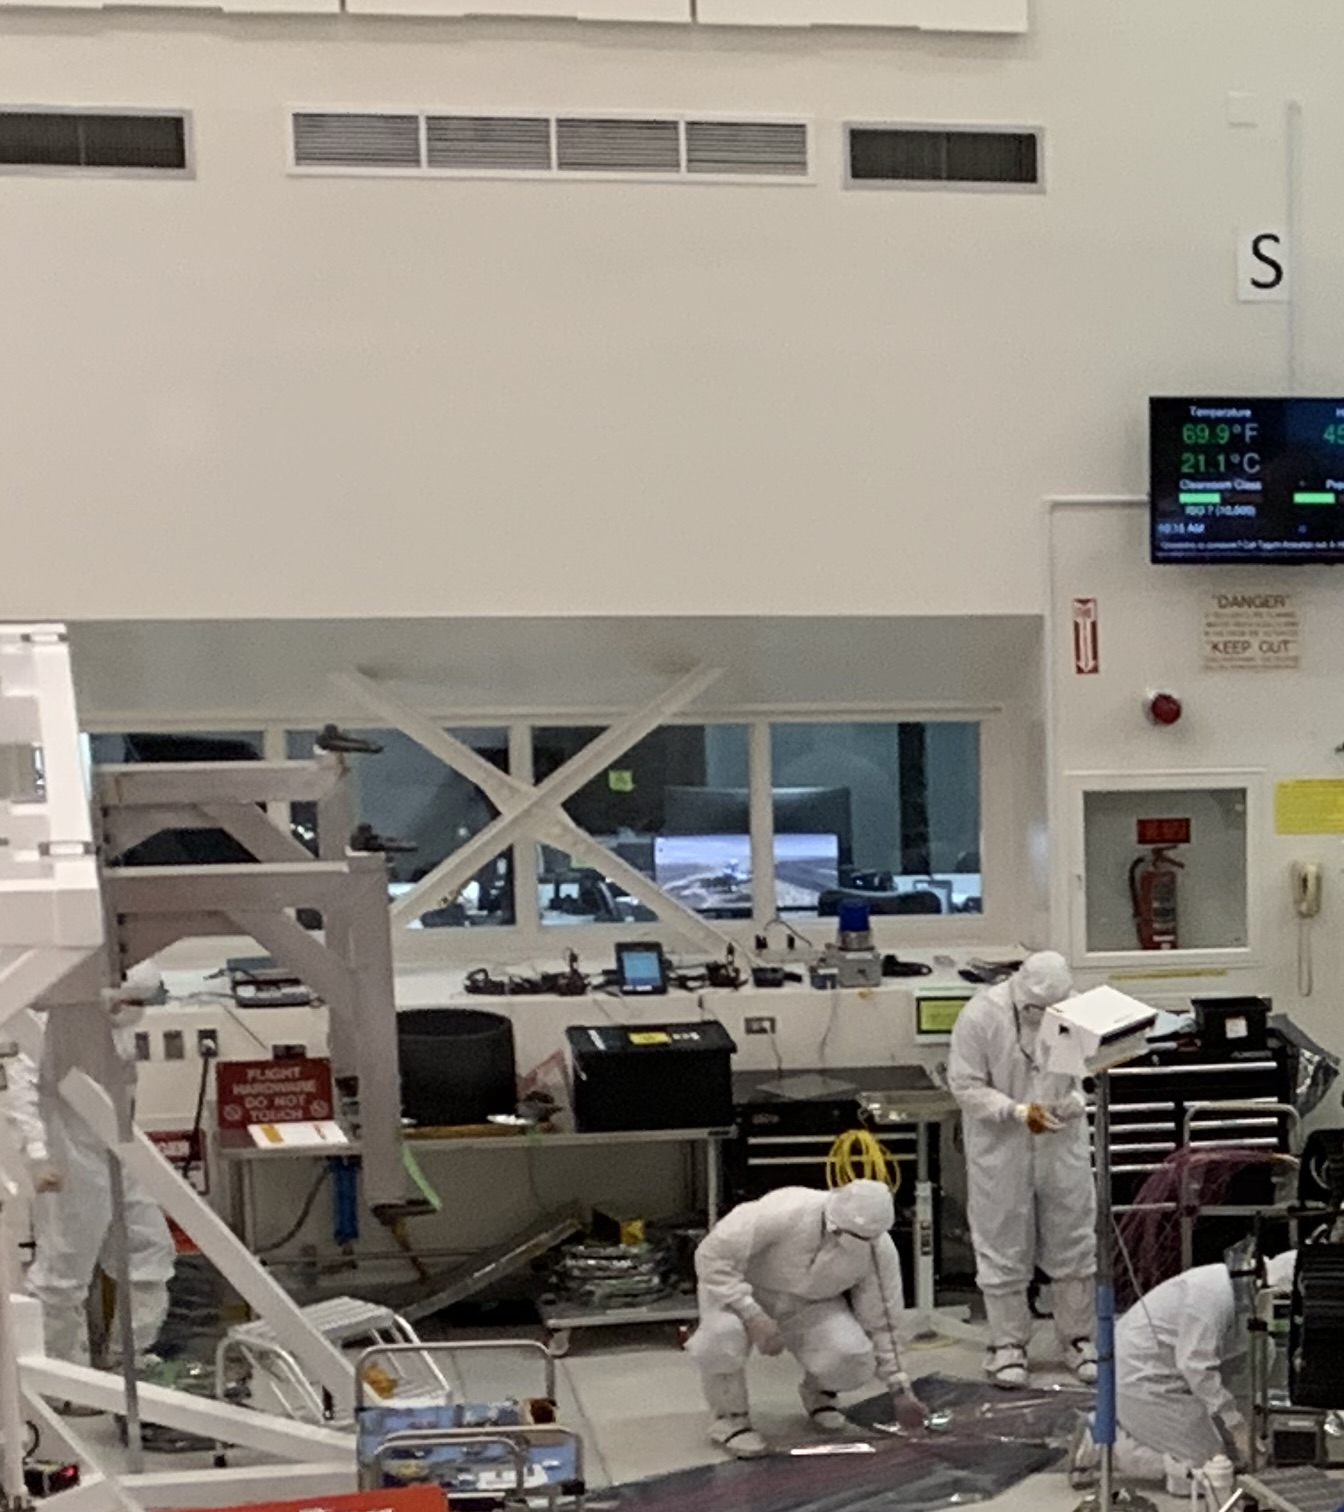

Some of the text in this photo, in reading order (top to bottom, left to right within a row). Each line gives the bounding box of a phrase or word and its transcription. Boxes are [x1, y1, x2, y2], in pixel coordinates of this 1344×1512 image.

[1250, 233, 1283, 289] S
[1189, 405, 1252, 419] Temperature
[246, 1067, 301, 1080] FLIGHT
[232, 1081, 317, 1096] HARDWARE
[245, 1093, 307, 1109] DO NOT
[249, 1108, 303, 1121] TOUCH
